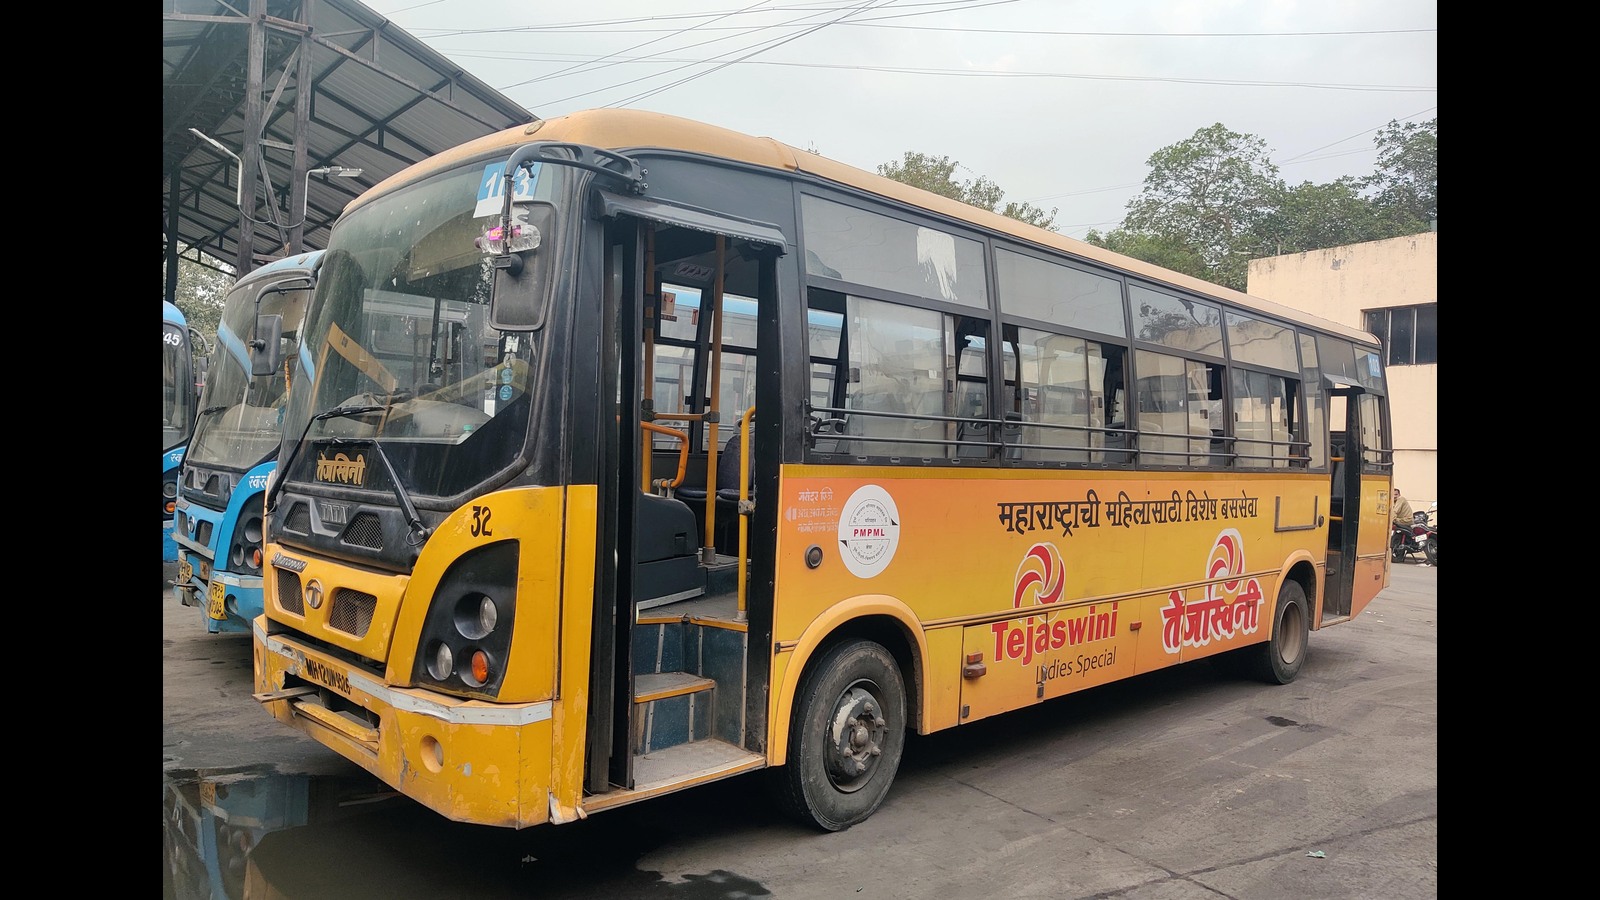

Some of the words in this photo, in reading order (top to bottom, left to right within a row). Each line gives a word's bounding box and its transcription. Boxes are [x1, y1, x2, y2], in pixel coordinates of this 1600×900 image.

[163, 332, 179, 346] 45
[316, 450, 366, 485] तेजस्विनी
[470, 505, 493, 537] 32
[997, 489, 1101, 537] महाराष्ट्राची
[1104, 490, 1182, 528] महिलांसाठी
[1185, 489, 1218, 521] विशेष
[1221, 489, 1258, 519] बससेवा
[853, 528, 885, 537] PMPML
[991, 601, 1118, 666] Tejaswini
[1036, 659, 1073, 685] Ldies
[1076, 646, 1117, 677] Special
